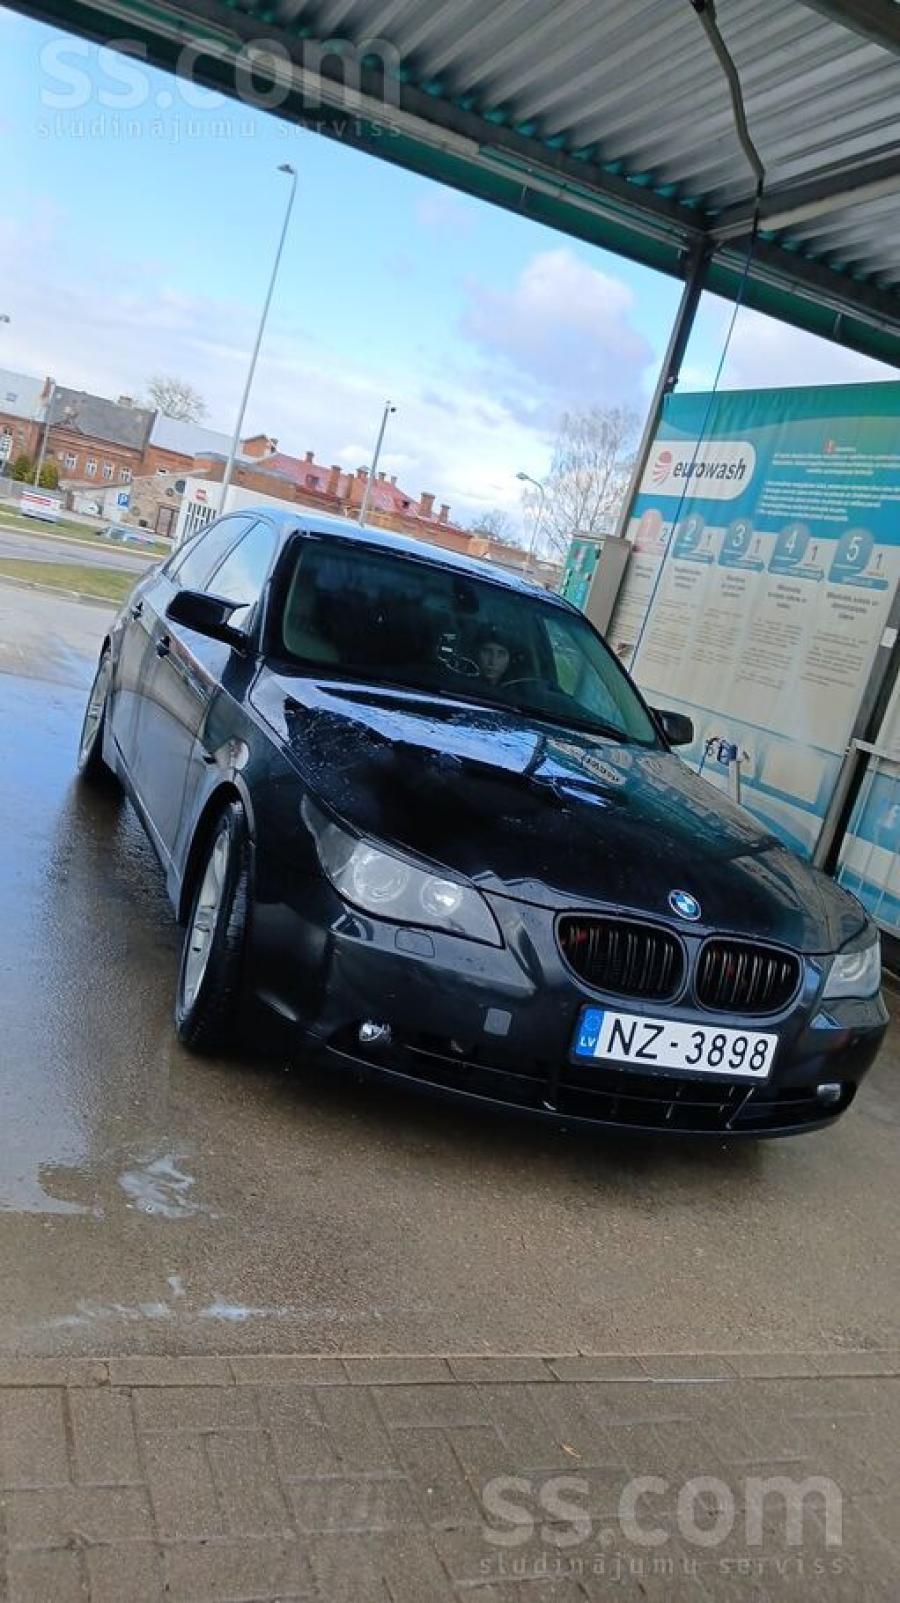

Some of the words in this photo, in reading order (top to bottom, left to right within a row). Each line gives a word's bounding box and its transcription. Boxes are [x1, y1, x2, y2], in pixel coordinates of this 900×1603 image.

[673, 457, 747, 480] eurowash
[684, 518, 697, 541] 2
[732, 523, 746, 547] 3
[784, 530, 798, 554] 4
[846, 536, 864, 562] 5
[580, 1035, 596, 1048] LV
[606, 1017, 769, 1072] NZ-3898
